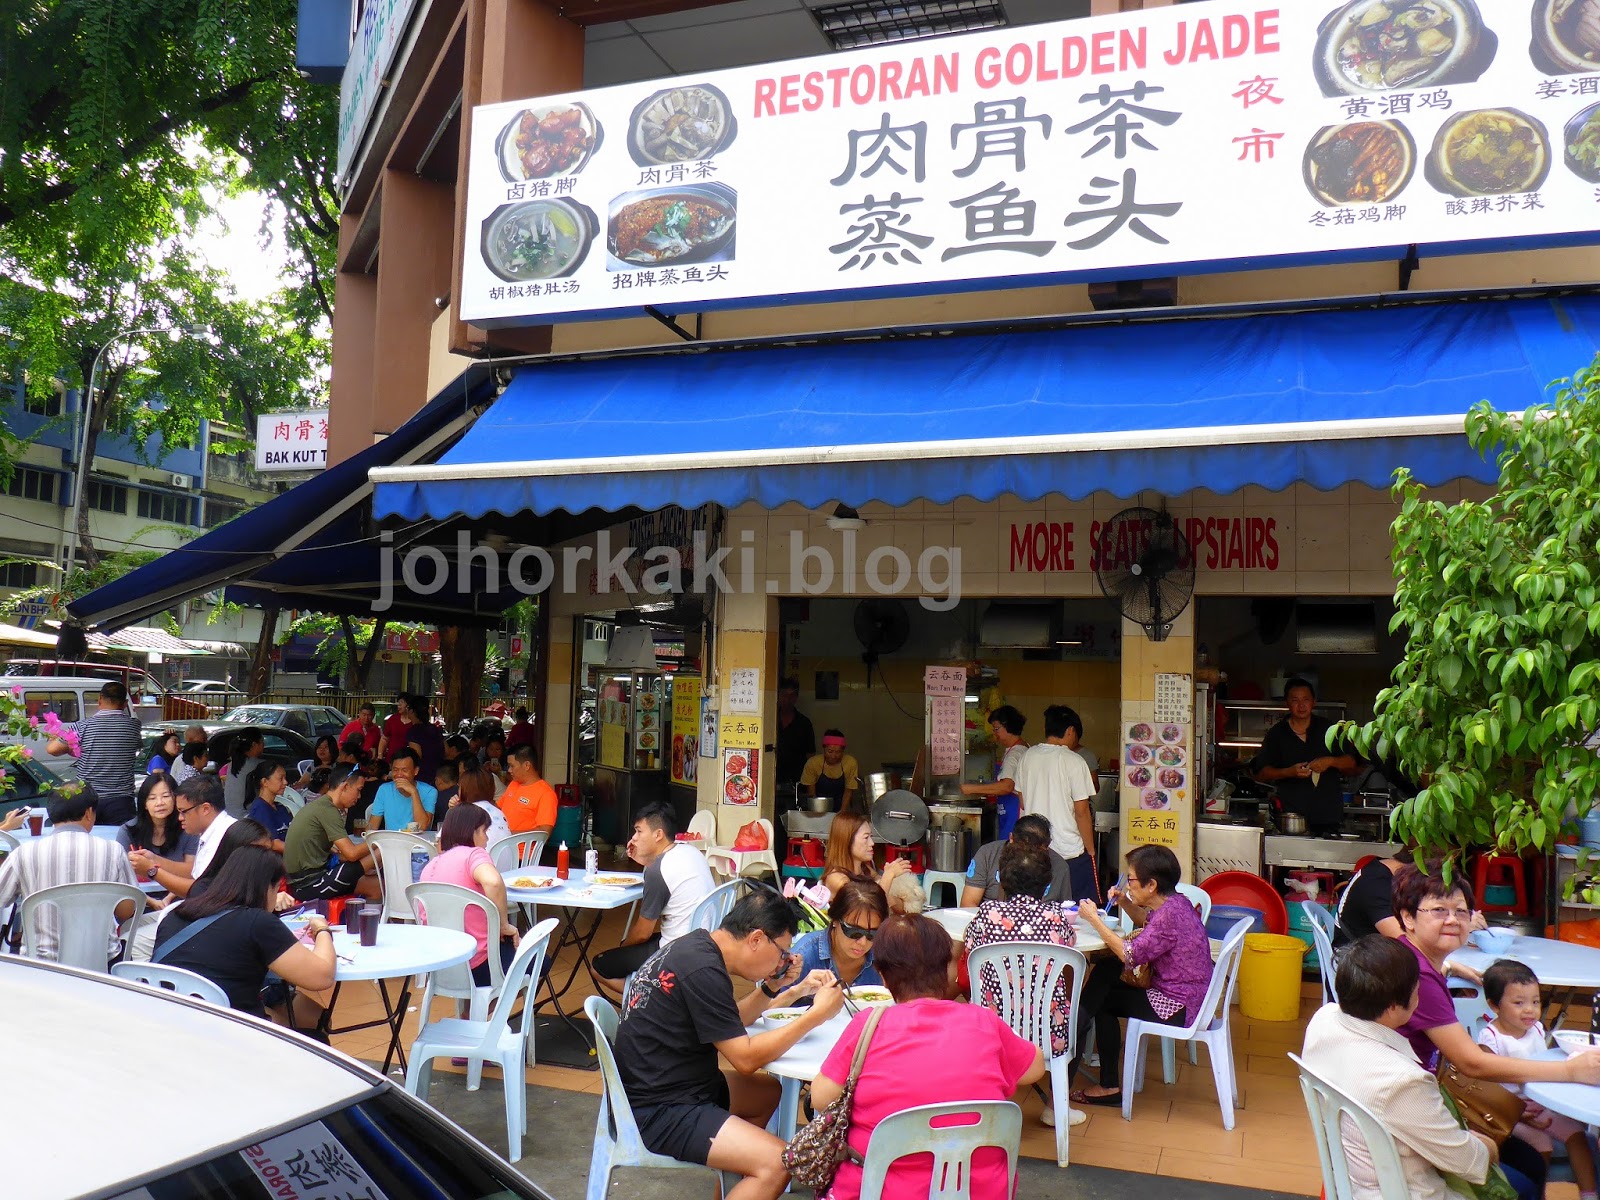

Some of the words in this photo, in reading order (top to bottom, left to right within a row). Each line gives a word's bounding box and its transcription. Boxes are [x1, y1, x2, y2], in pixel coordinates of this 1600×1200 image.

[754, 52, 959, 118] RESTORAN
[975, 27, 1147, 89] GOLDEN
[1164, 9, 1280, 64] JADE
[1340, 89, 1452, 120] 黄酒鸡
[1232, 75, 1285, 163] 夜市
[830, 80, 1183, 186] 肉骨茶
[636, 160, 718, 186] 肉骨茶
[507, 177, 577, 201] 卤猪脚
[1308, 203, 1407, 228] 冬菇鸡脚
[1445, 193, 1545, 216] 酸辣芥菜
[829, 168, 1184, 271] 蒸鱼头
[612, 264, 729, 290] 招牌蒸鱼头
[489, 280, 580, 301] 胡椒猪肚汤
[265, 451, 289, 464] BAK
[293, 450, 317, 463] KUT
[1010, 521, 1075, 572] MORE
[1173, 516, 1279, 571] UPSTAIRS
[929, 670, 963, 681] 云吞面
[722, 722, 759, 735] 云吞面
[1131, 816, 1176, 831] 云吞面
